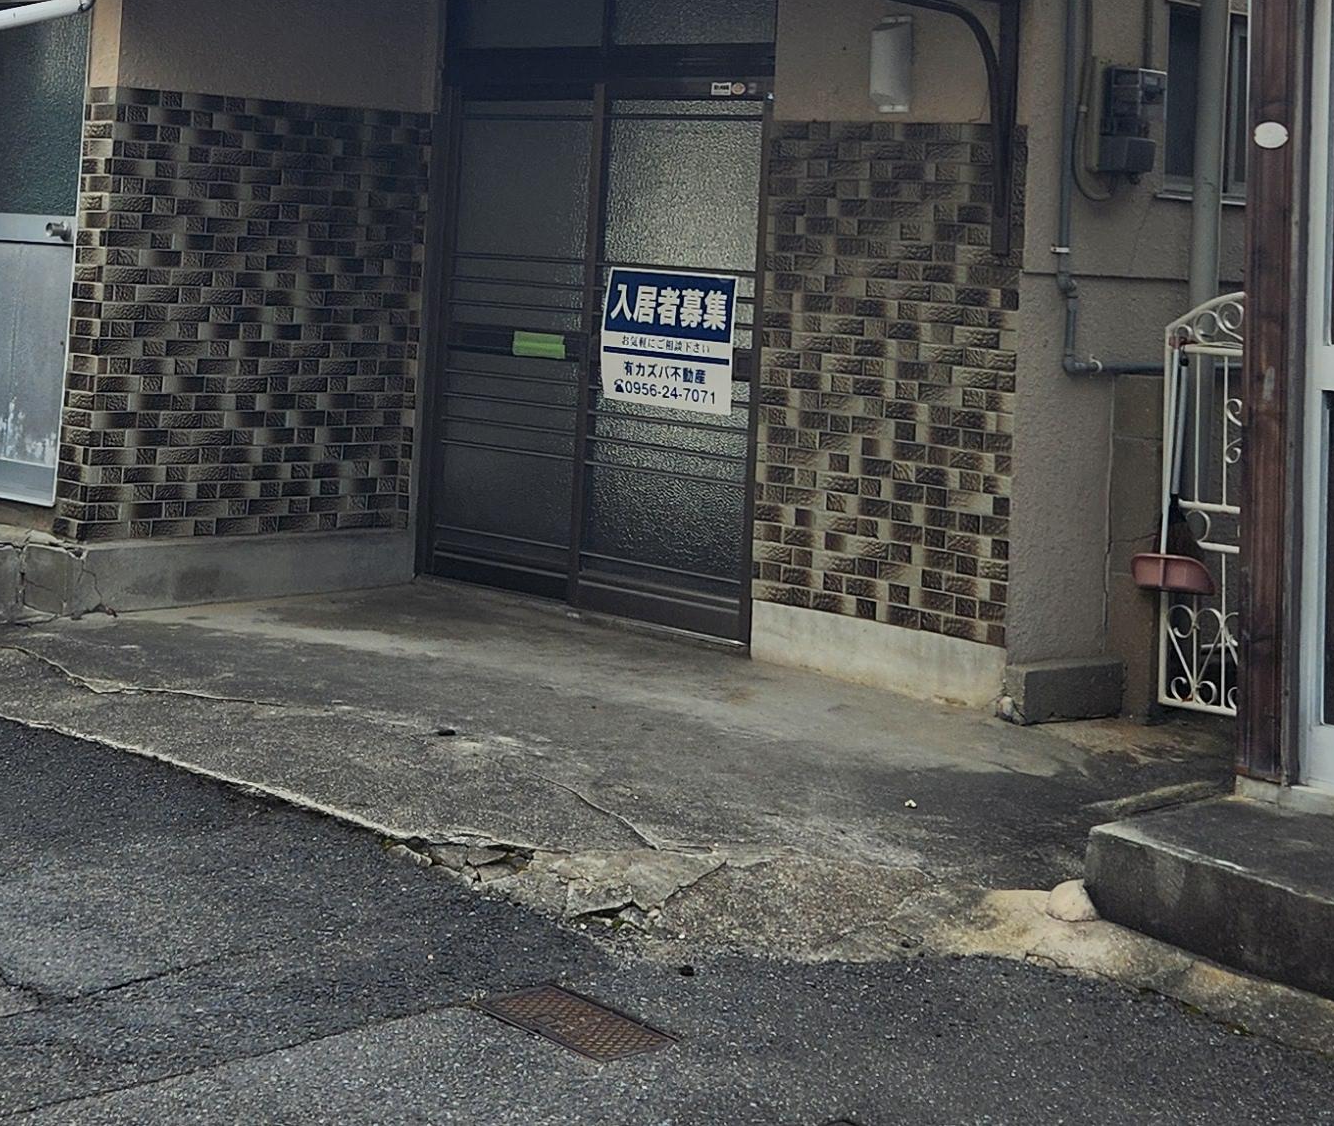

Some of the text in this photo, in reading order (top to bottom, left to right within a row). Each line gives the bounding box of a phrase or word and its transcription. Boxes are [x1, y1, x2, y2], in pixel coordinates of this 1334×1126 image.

[610, 284, 728, 331] 入居者募集
[621, 335, 710, 353] お気軽にご相談下さい
[625, 381, 715, 405] 0956-24-7071
